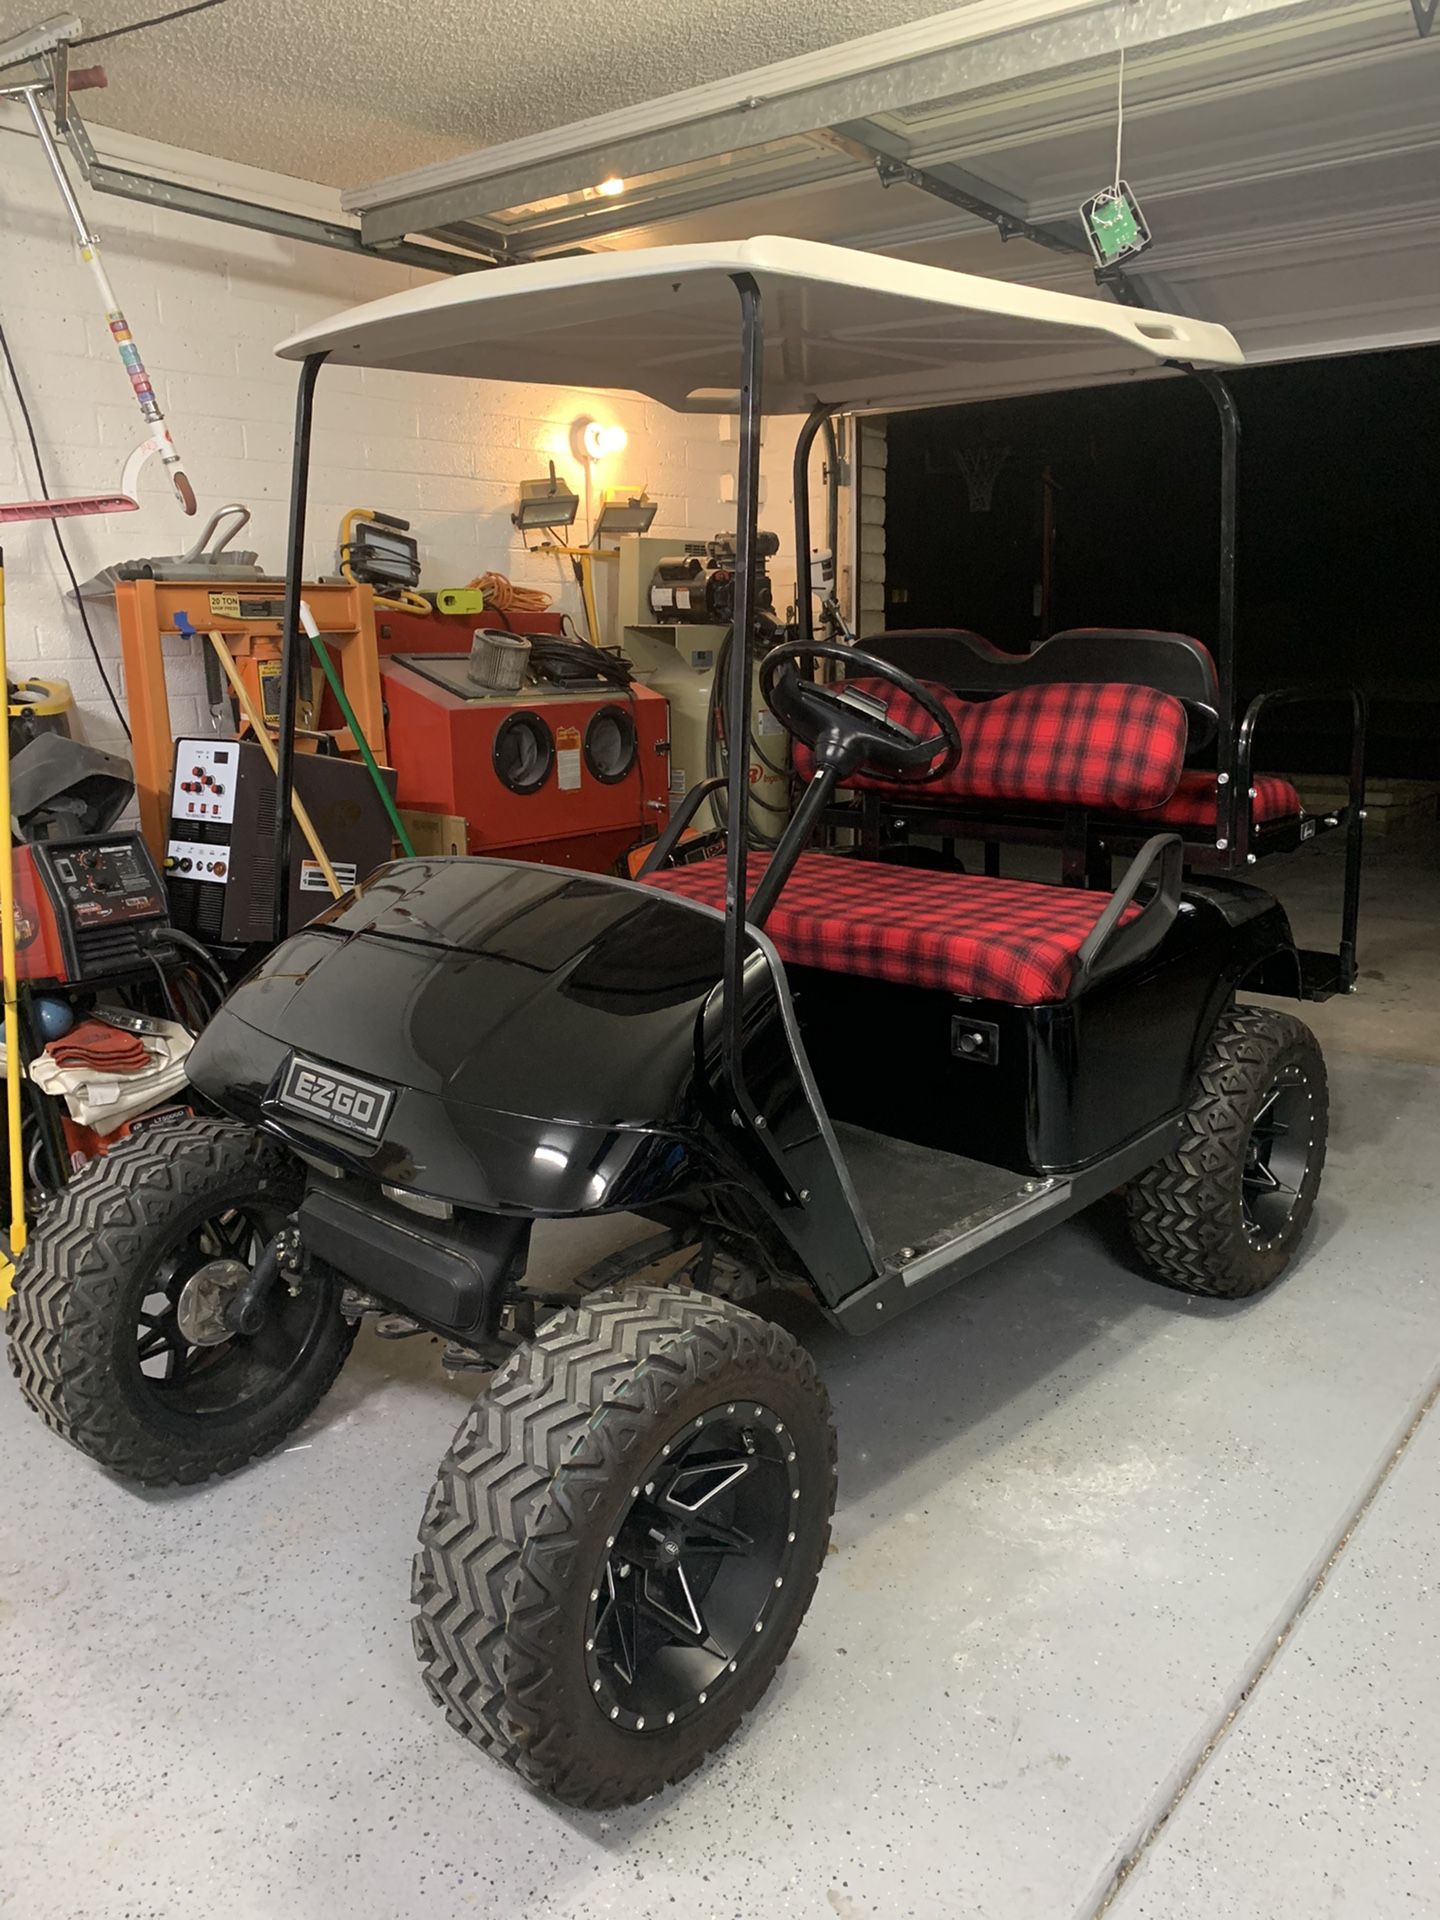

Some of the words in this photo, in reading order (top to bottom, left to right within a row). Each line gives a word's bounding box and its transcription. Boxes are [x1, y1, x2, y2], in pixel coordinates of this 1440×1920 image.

[211, 597, 221, 605] 20
[222, 597, 238, 605] TON
[294, 1071, 376, 1123] EZGO
